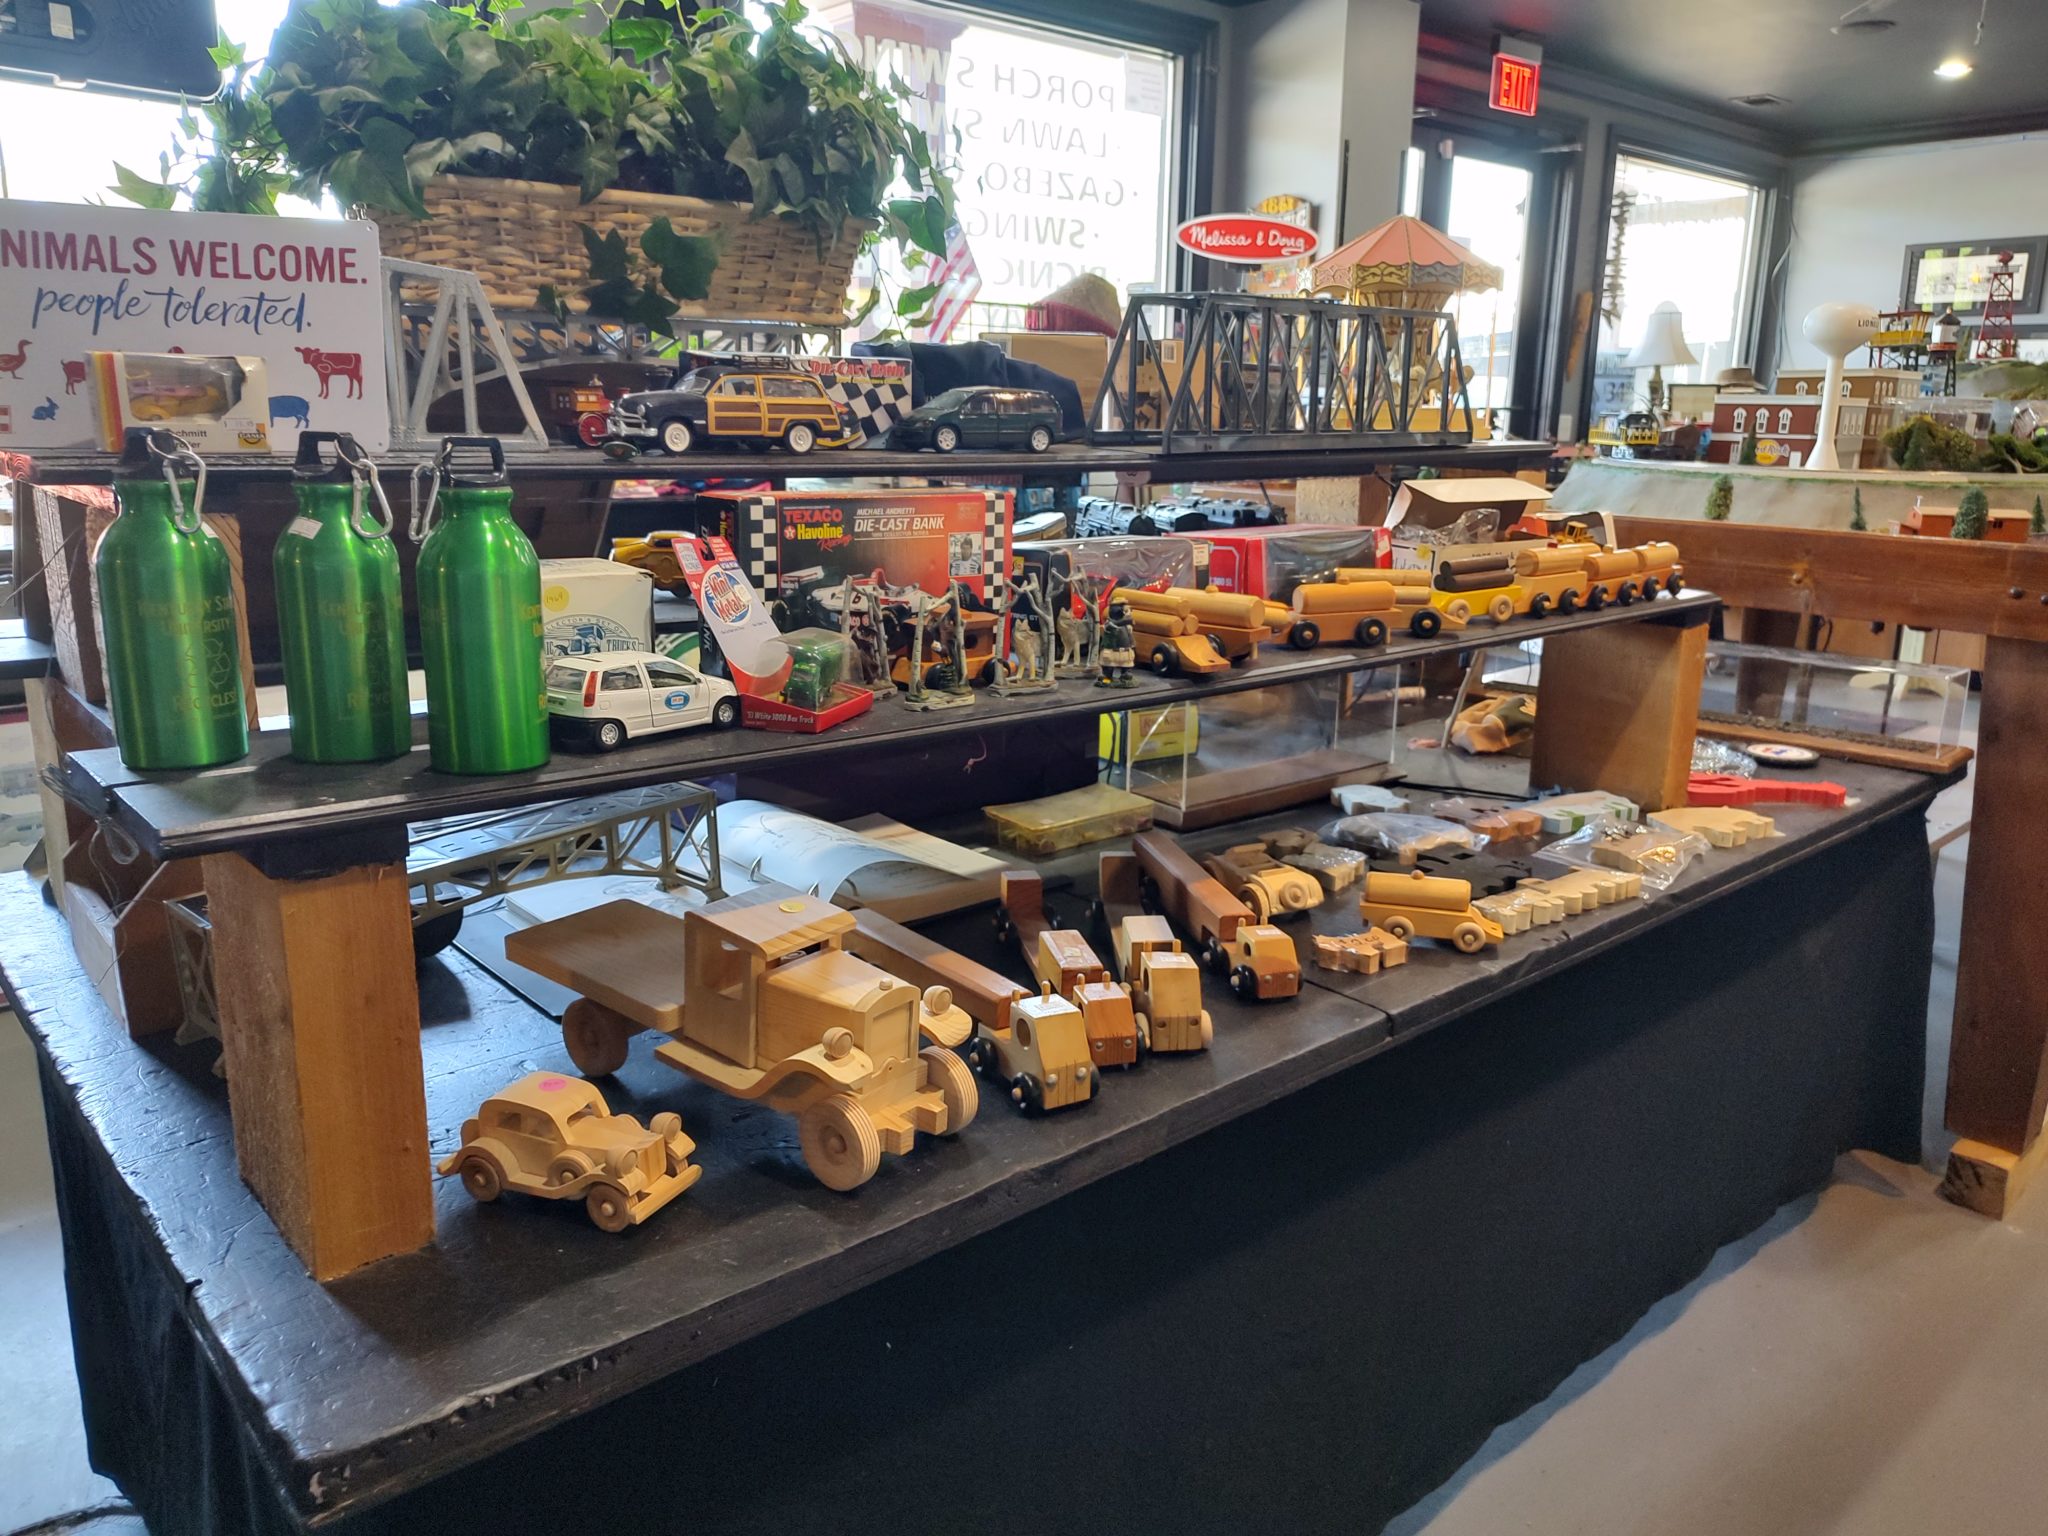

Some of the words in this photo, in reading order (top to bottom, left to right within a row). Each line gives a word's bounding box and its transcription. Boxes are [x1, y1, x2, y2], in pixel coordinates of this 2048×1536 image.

[1499, 61, 1533, 111] EXIT
[1189, 225, 1252, 249] Melissa
[1268, 229, 1305, 256] Doug
[0, 228, 157, 275] NIMALS
[169, 239, 368, 285] WELCOME.
[32, 278, 152, 336] people
[144, 285, 313, 336] tolerated.
[784, 508, 843, 524] TEXACO
[856, 507, 884, 516] MICHAEL
[886, 507, 916, 515] ANDRETTI
[797, 523, 844, 541] Havoline
[853, 517, 910, 533] DIE-CAST
[912, 516, 945, 530] BANK
[708, 570, 732, 599] Mini
[606, 639, 637, 652] TRUCKS
